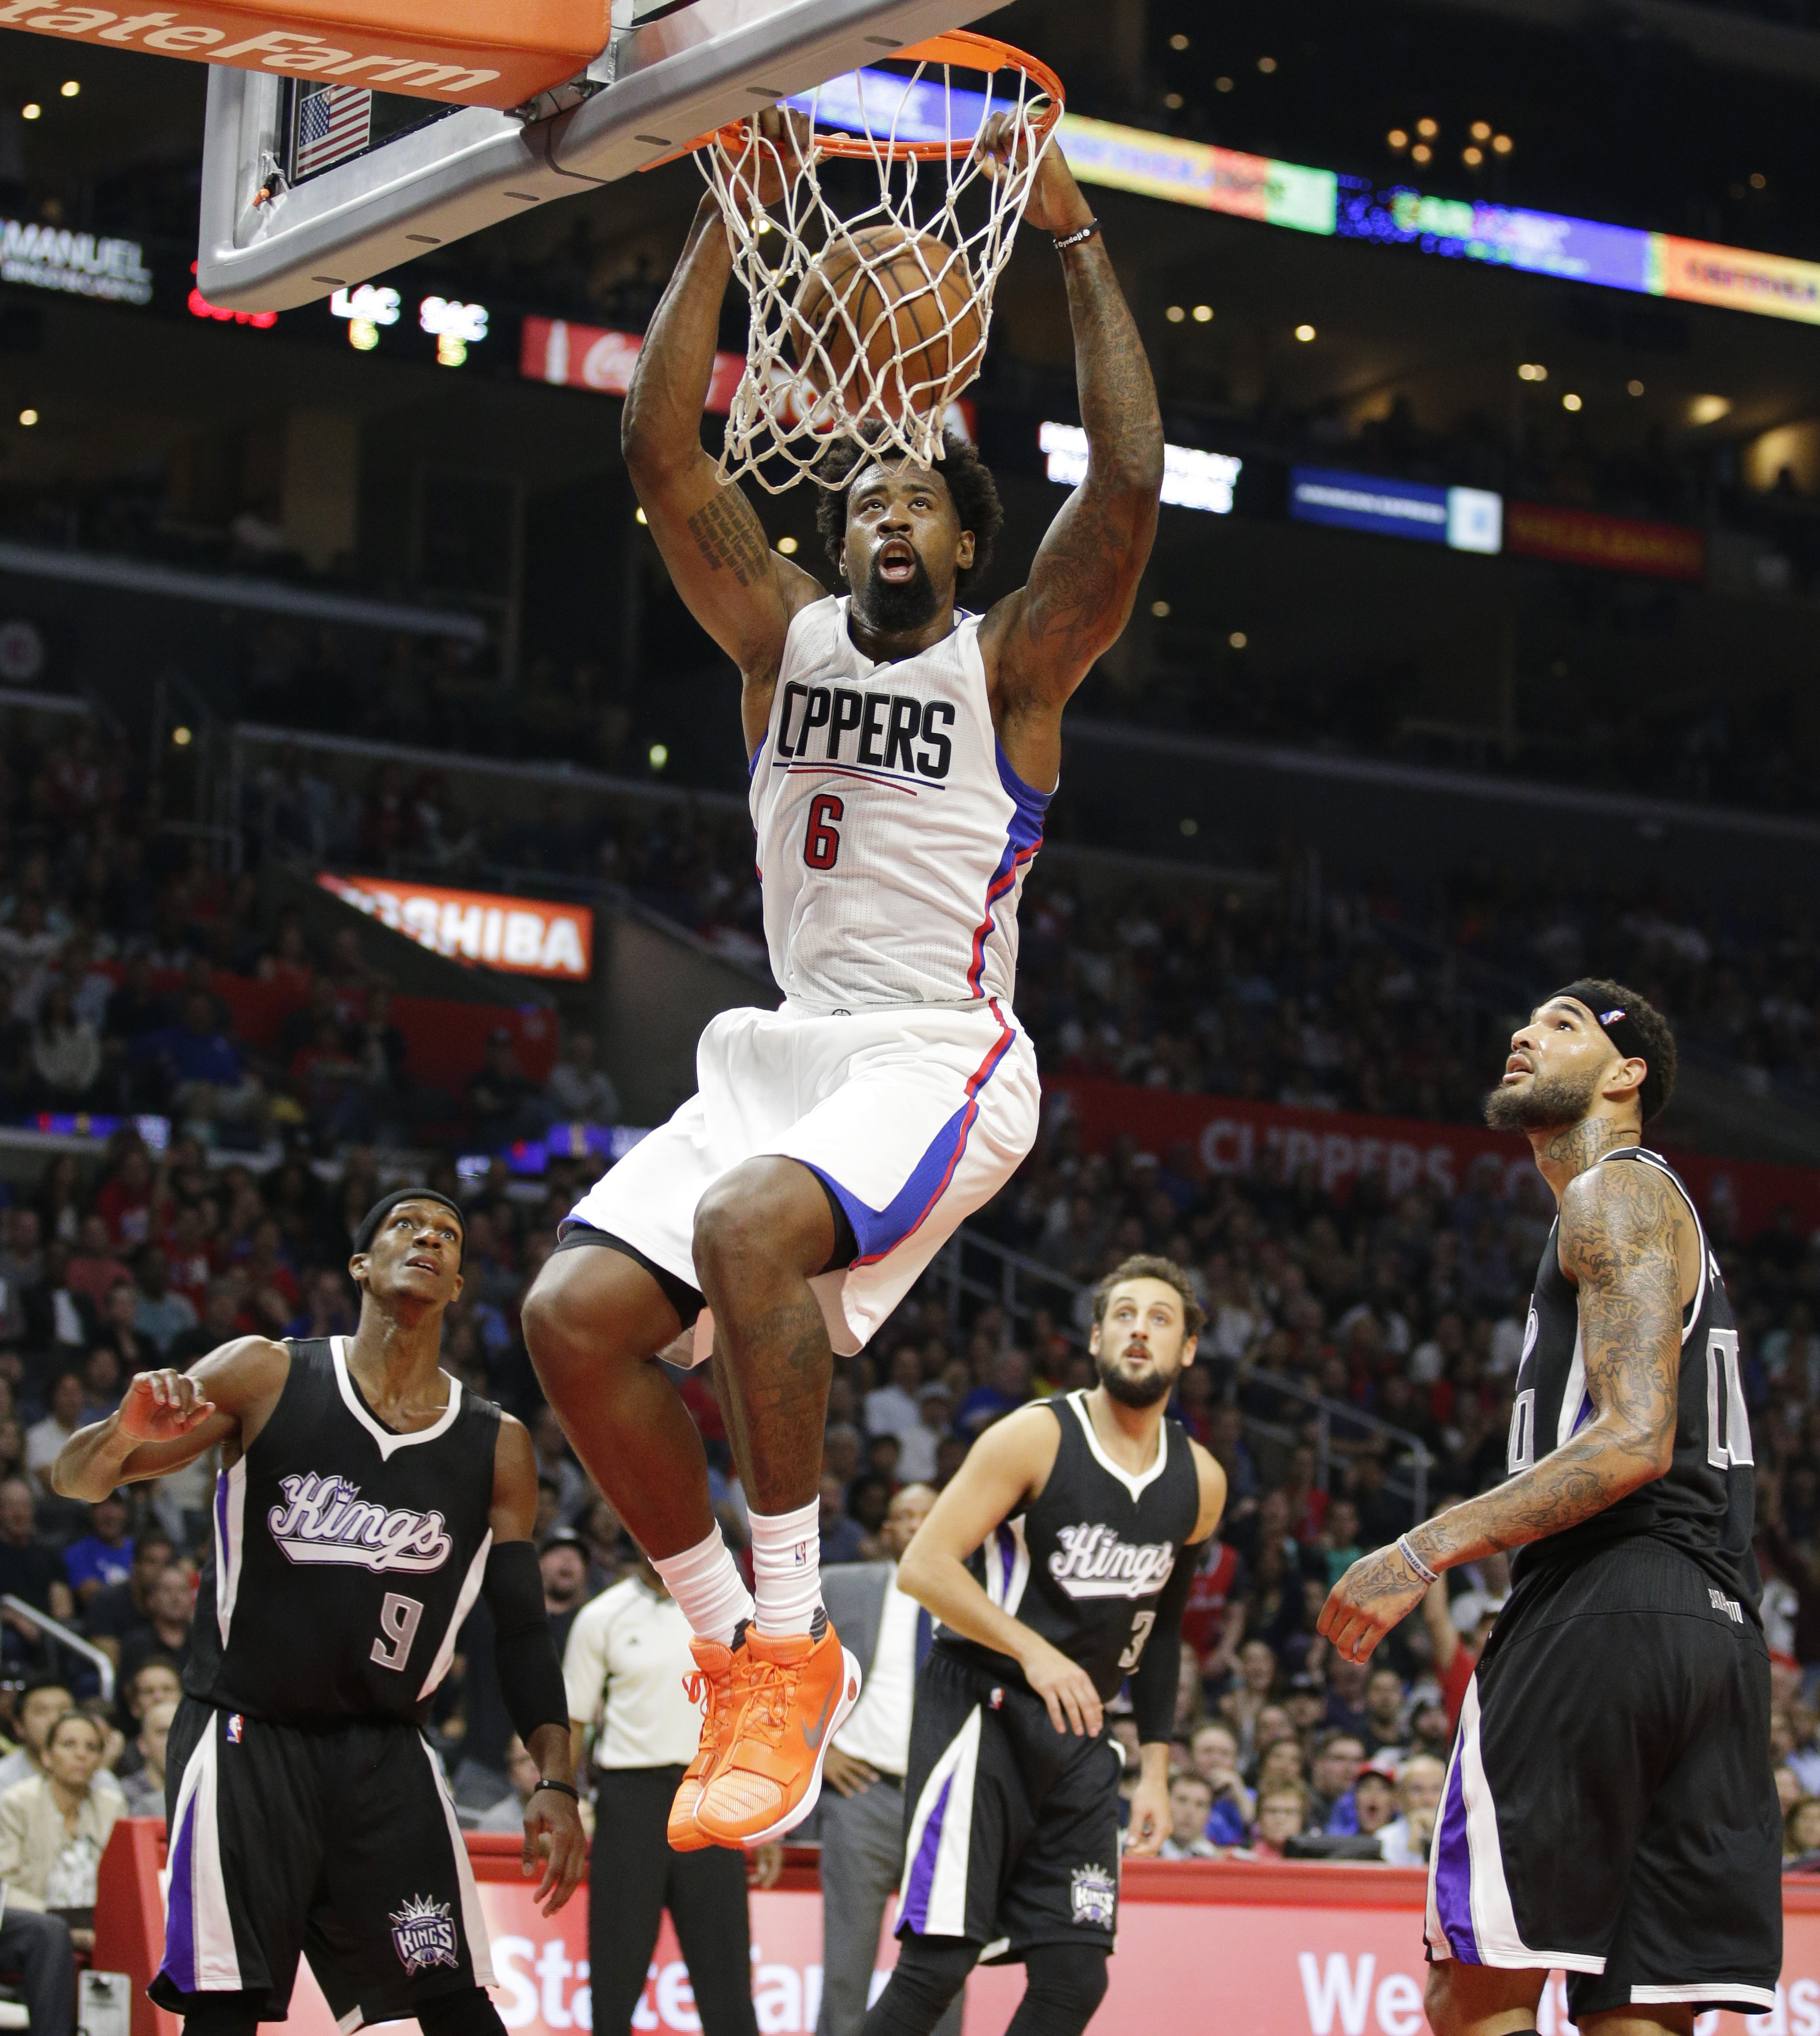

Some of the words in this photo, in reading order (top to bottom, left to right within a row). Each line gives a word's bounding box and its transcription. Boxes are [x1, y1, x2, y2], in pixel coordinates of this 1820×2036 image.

[0, 0, 225, 51] tate
[206, 30, 501, 92] Farm
[804, 793, 844, 870] 6
[268, 1471, 453, 1573] Kings
[1049, 1522, 1175, 1601] Kings
[1399, 1542, 1421, 1570] OTHERS
[370, 1592, 424, 1672] 9
[1117, 1610, 1156, 1676] 3
[397, 1923, 453, 1959] KINGS
[488, 1935, 703, 2031] Stte
